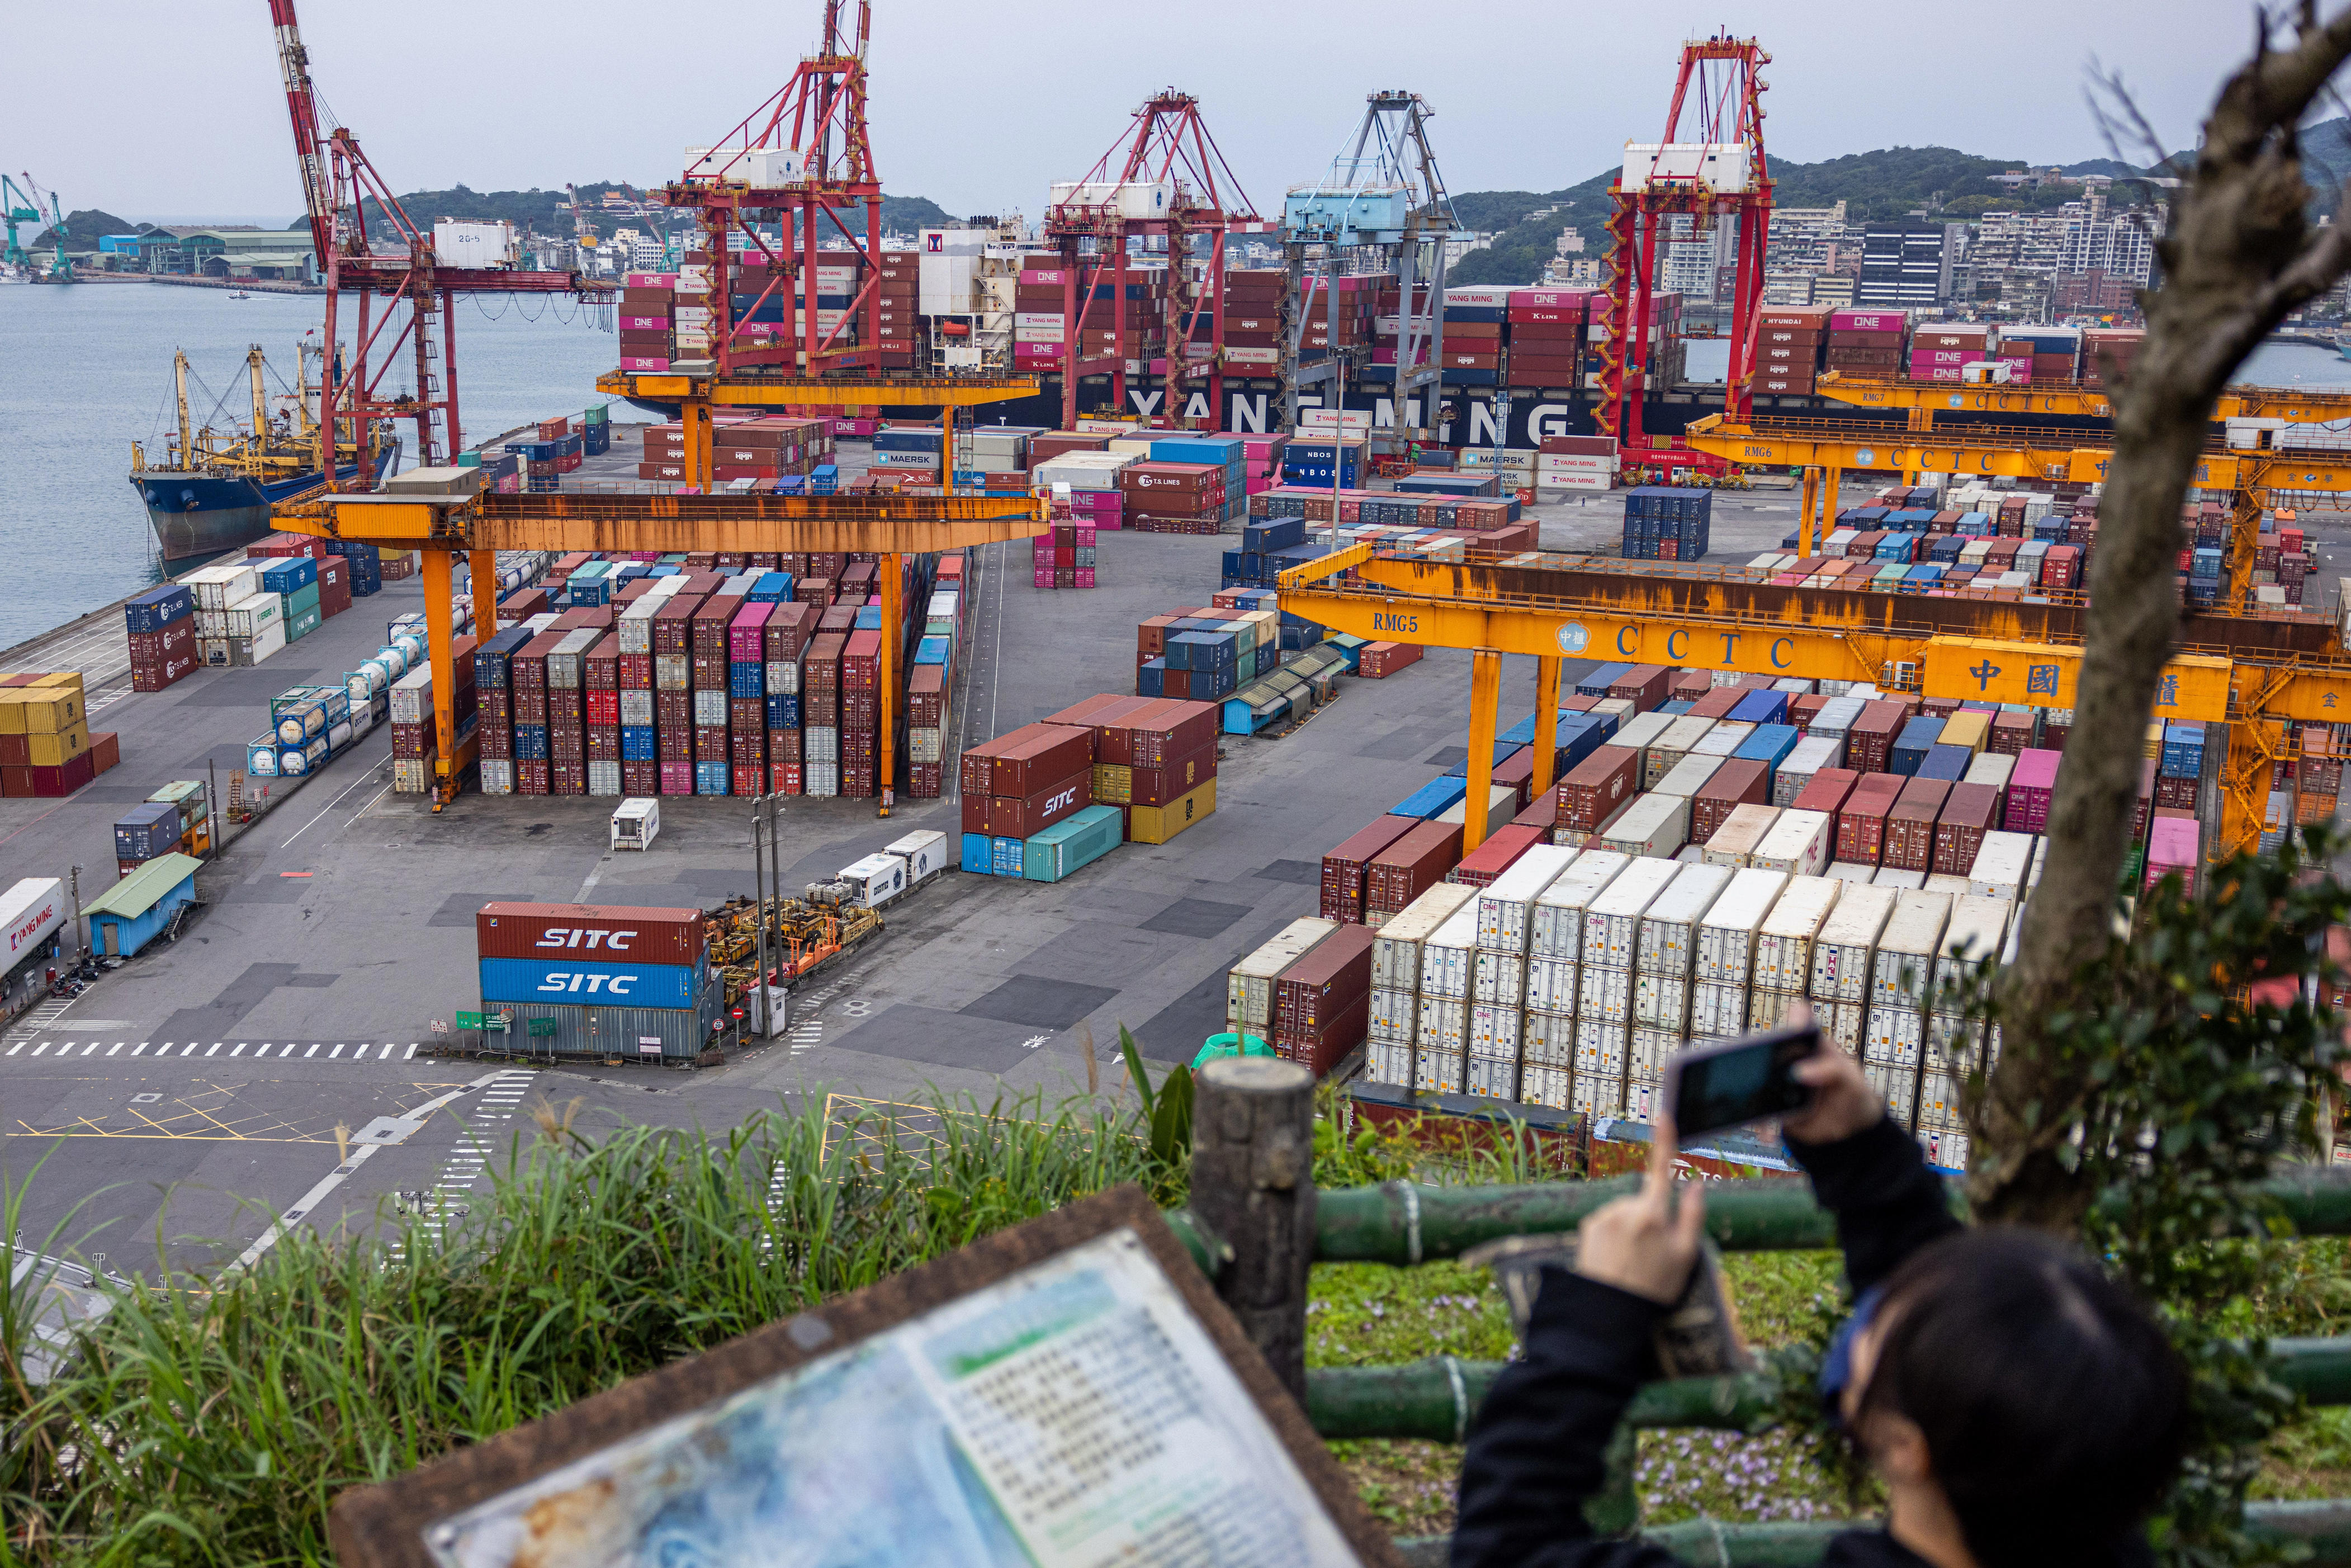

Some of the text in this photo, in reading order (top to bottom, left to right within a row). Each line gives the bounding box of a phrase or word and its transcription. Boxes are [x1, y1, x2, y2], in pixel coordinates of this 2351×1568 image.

[1038, 272, 1058, 281] ONE
[1534, 294, 1557, 304] ONE
[1854, 317, 1879, 326] ONE
[751, 324, 769, 332] ONE
[1773, 333, 1791, 341] HMM
[1941, 337, 1959, 345] HMM
[1033, 344, 1053, 353] ONE
[1771, 349, 1790, 358] HMM
[1935, 352, 1961, 362] ONE
[1770, 365, 1789, 373] HMM
[1933, 368, 1959, 378] ONE
[1768, 381, 1787, 390] HMM
[1862, 392, 1885, 402] RMG7
[735, 452, 753, 461] HMM
[1744, 446, 1772, 458] RMG6
[890, 455, 930, 463] MAERSK
[663, 467, 679, 476] HMM
[918, 474, 931, 482] SÜD
[1373, 612, 1418, 633] RMG5
[1560, 629, 1586, 646] 中櫃
[2321, 691, 2340, 708] 金
[1042, 786, 1076, 817] SITC
[873, 880, 889, 896] CCTC
[1538, 909, 1550, 918] tex
[17, 921, 36, 944] YANG
[36, 904, 53, 927] MING
[850, 925, 866, 938] ZPMC
[535, 928, 638, 950] SITC
[537, 973, 638, 994] SITC
